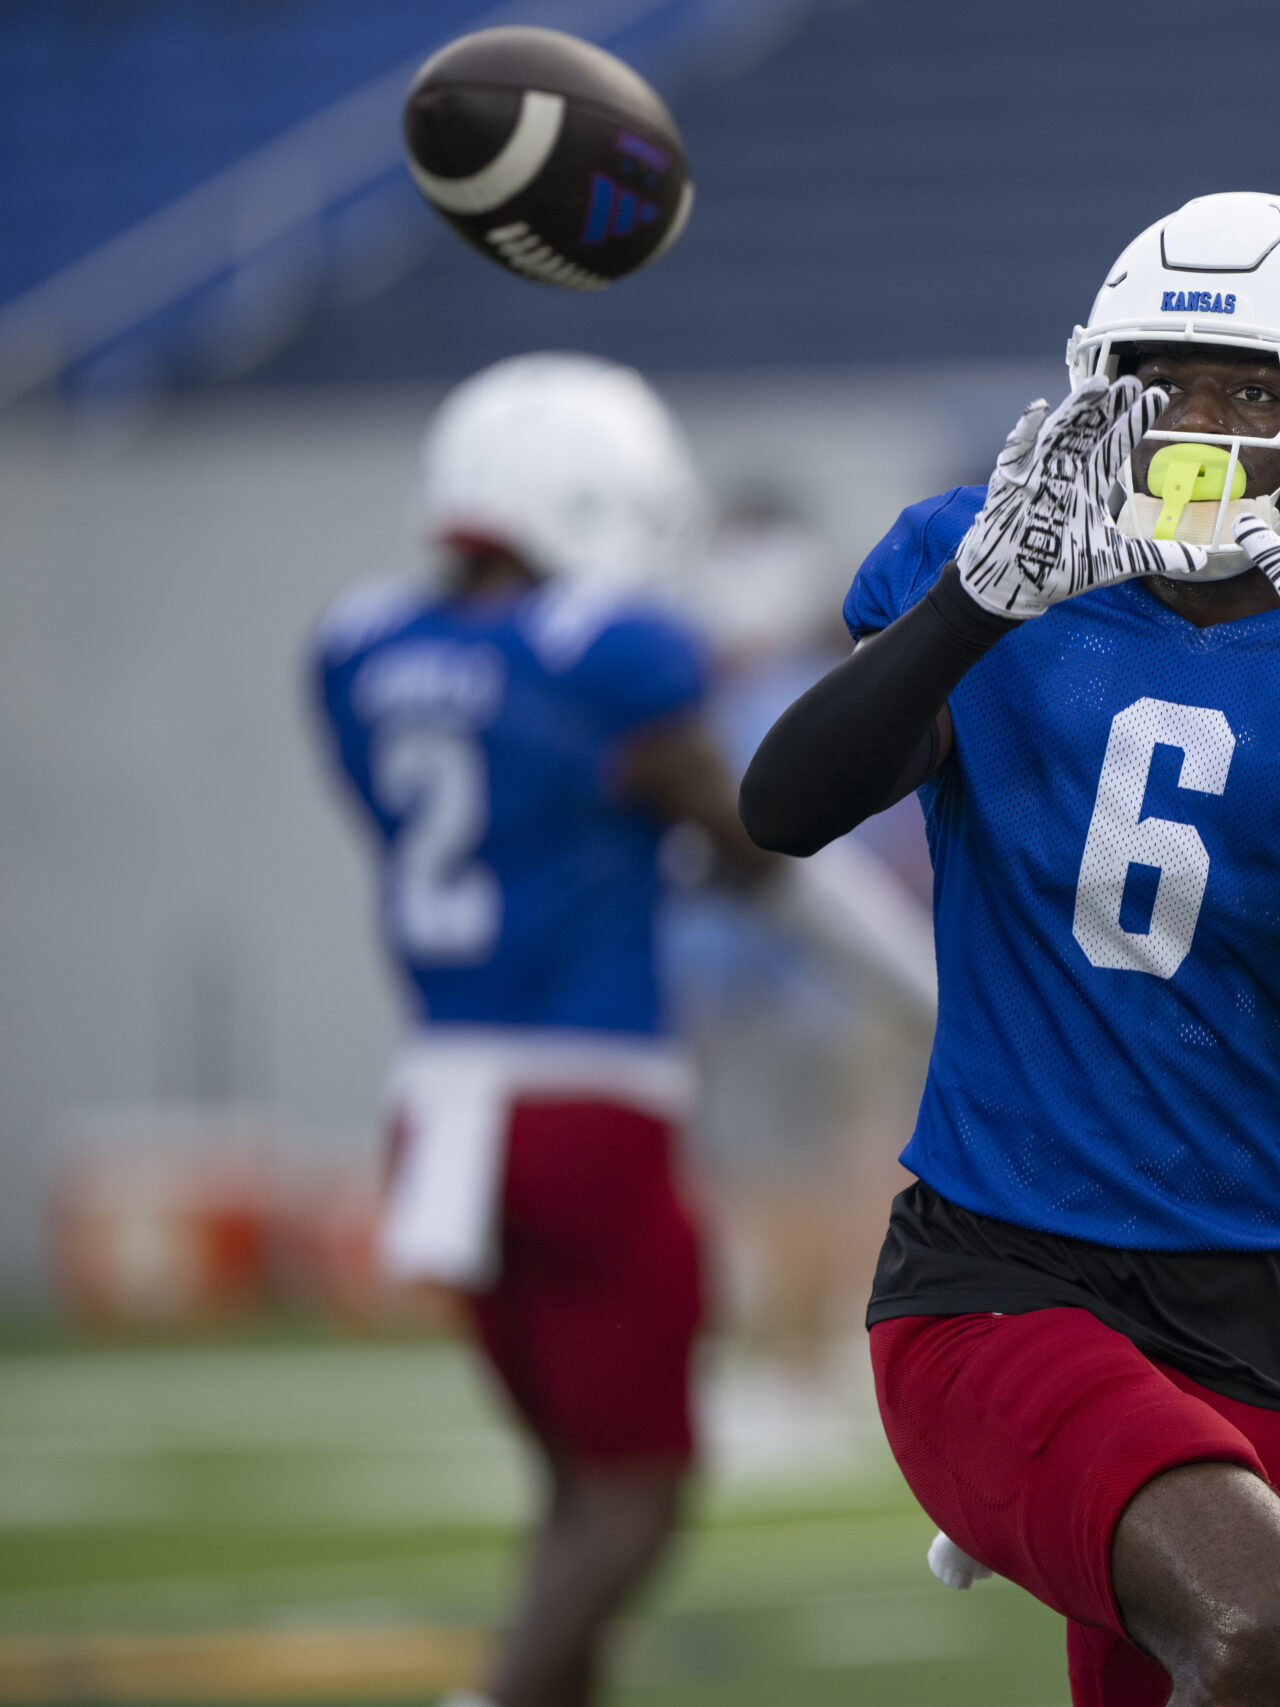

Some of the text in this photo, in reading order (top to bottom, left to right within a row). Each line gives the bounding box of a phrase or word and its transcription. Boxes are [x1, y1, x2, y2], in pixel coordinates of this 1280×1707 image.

[1160, 291, 1237, 314] KANSAS
[372, 728, 504, 964] 2
[1072, 696, 1236, 980] 6
